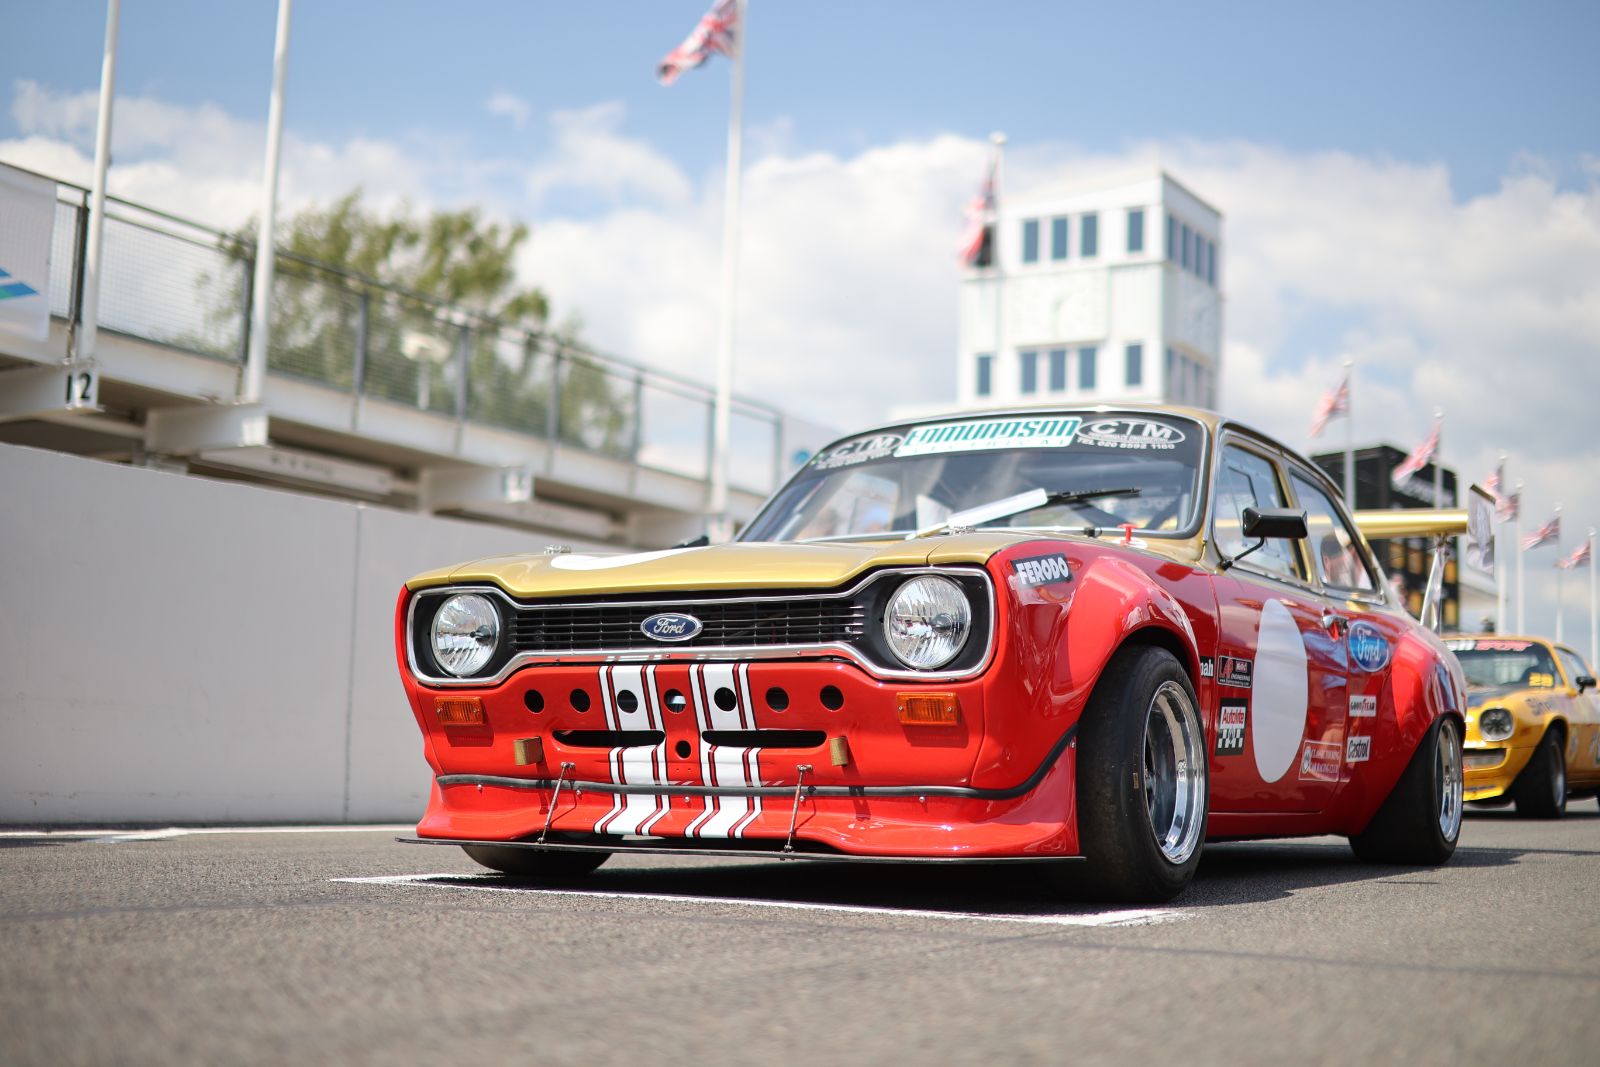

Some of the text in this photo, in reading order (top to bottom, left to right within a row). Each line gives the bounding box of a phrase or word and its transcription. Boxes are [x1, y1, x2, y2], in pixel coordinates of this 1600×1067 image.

[66, 373, 92, 403] 12
[1090, 420, 1173, 439] CTM
[1015, 557, 1069, 585] FERODO
[653, 617, 687, 634] Ford
[1356, 626, 1381, 662] Ford
[1350, 699, 1376, 711] GOODYEAR
[1221, 708, 1245, 725] Autolite
[1348, 739, 1370, 759] Castrol
